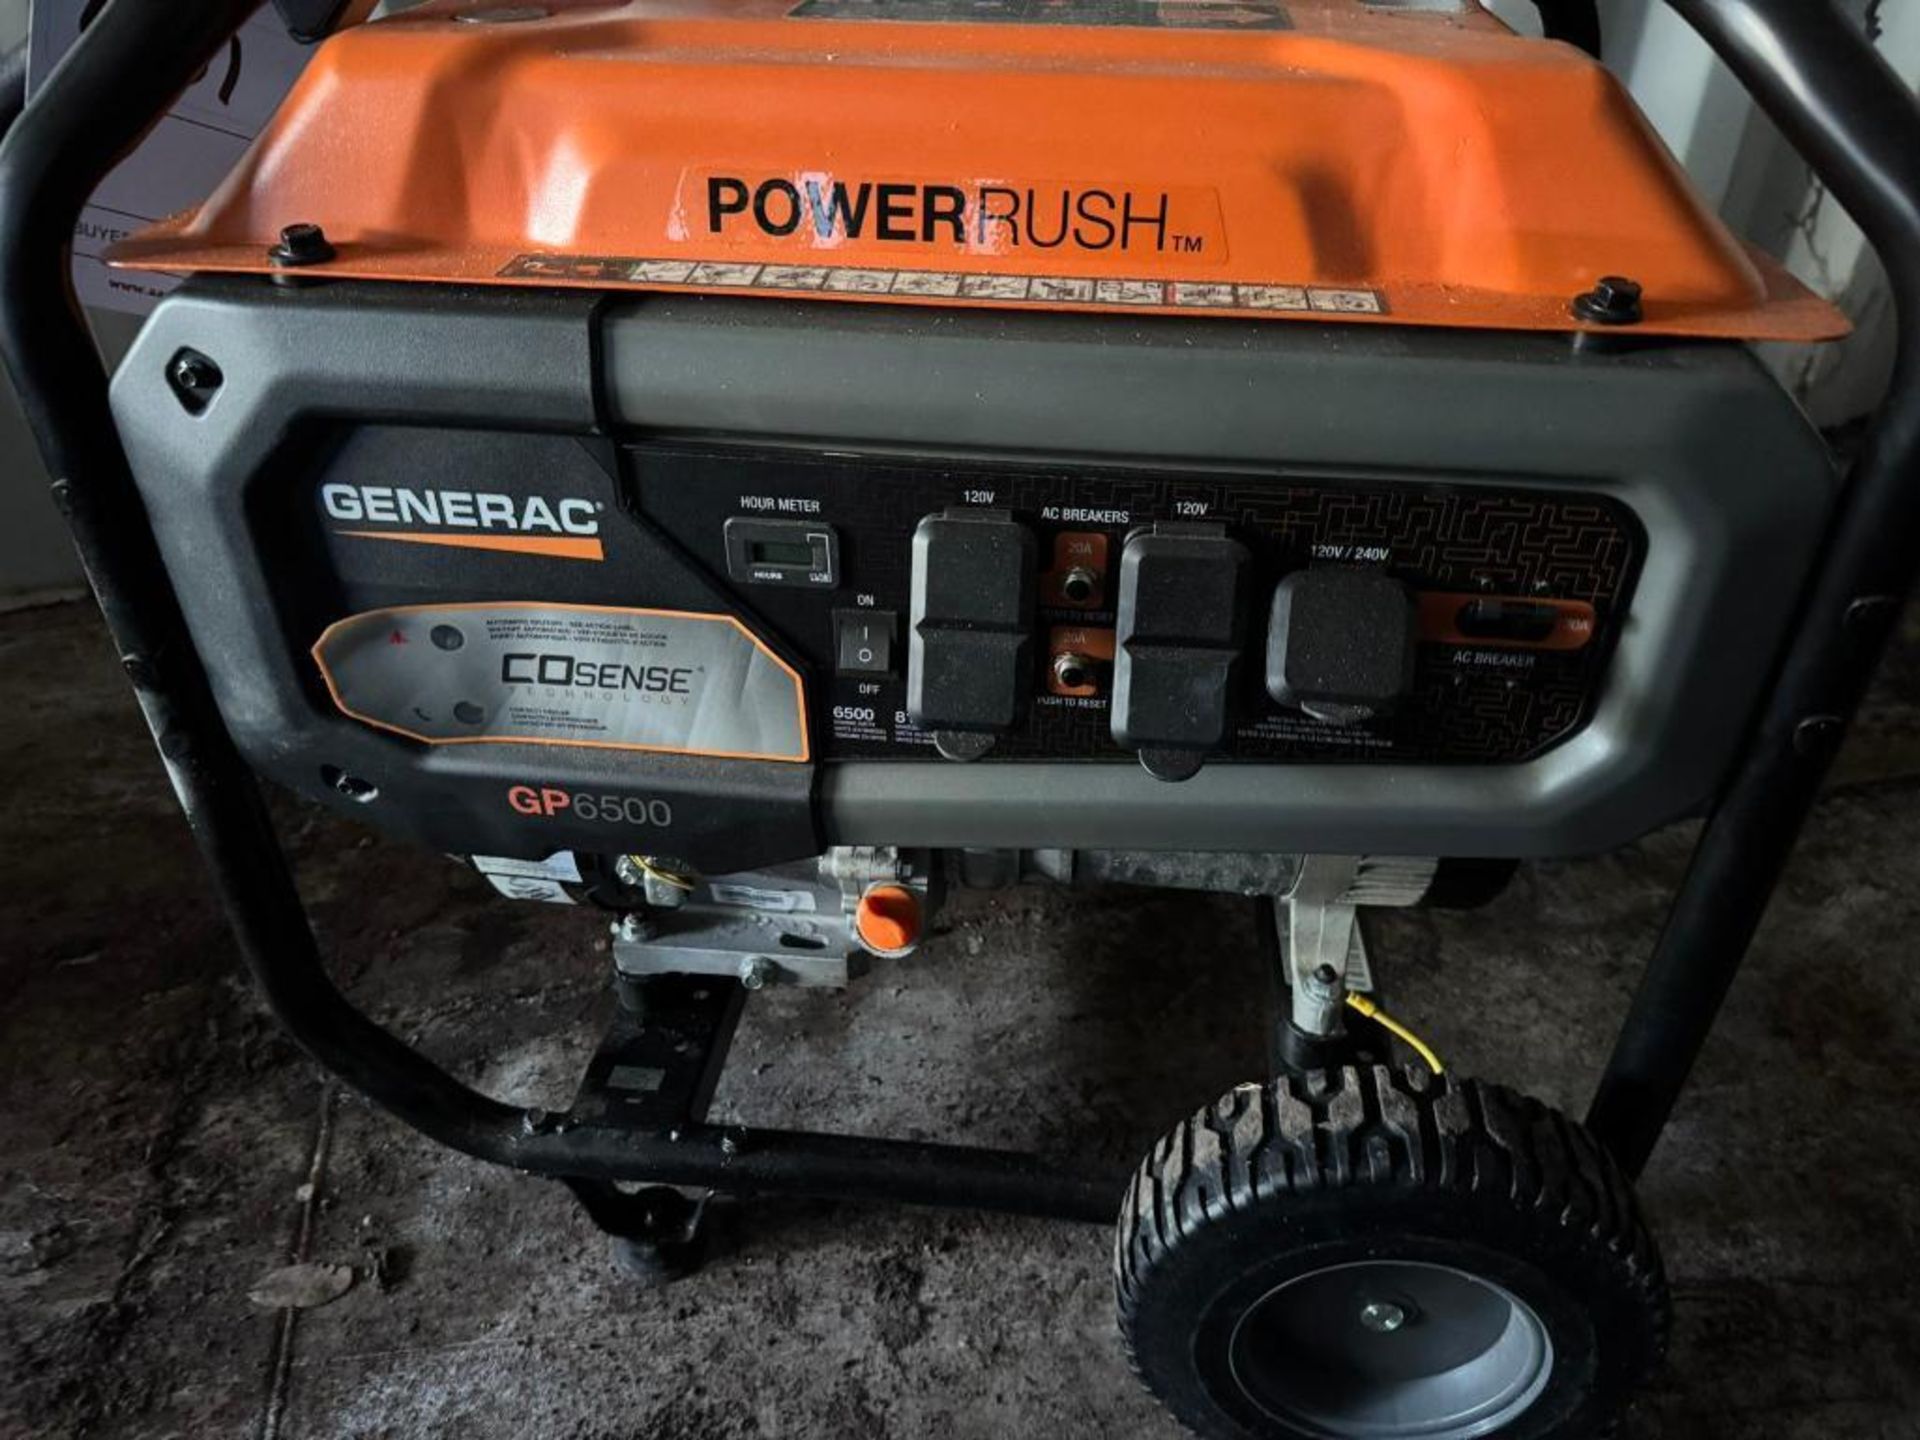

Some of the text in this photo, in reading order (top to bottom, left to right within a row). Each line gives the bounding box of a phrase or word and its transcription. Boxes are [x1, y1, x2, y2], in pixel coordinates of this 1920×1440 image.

[740, 496, 821, 513] HOUR METER
[963, 490, 996, 504] 120V
[321, 482, 599, 536] GENERAC
[1041, 507, 1130, 524] AC BREAKERS
[1175, 501, 1209, 516] 120V
[1310, 545, 1345, 559] 120V
[1354, 547, 1390, 561] 240V
[857, 594, 875, 607] ON
[1453, 651, 1536, 668] AC BREAKER
[501, 653, 693, 694] COSENSE
[858, 682, 881, 696] OFF
[1064, 696, 1077, 708] TO
[1078, 697, 1107, 709] RESET
[832, 706, 876, 721] 6500
[507, 785, 673, 828] GP6500
